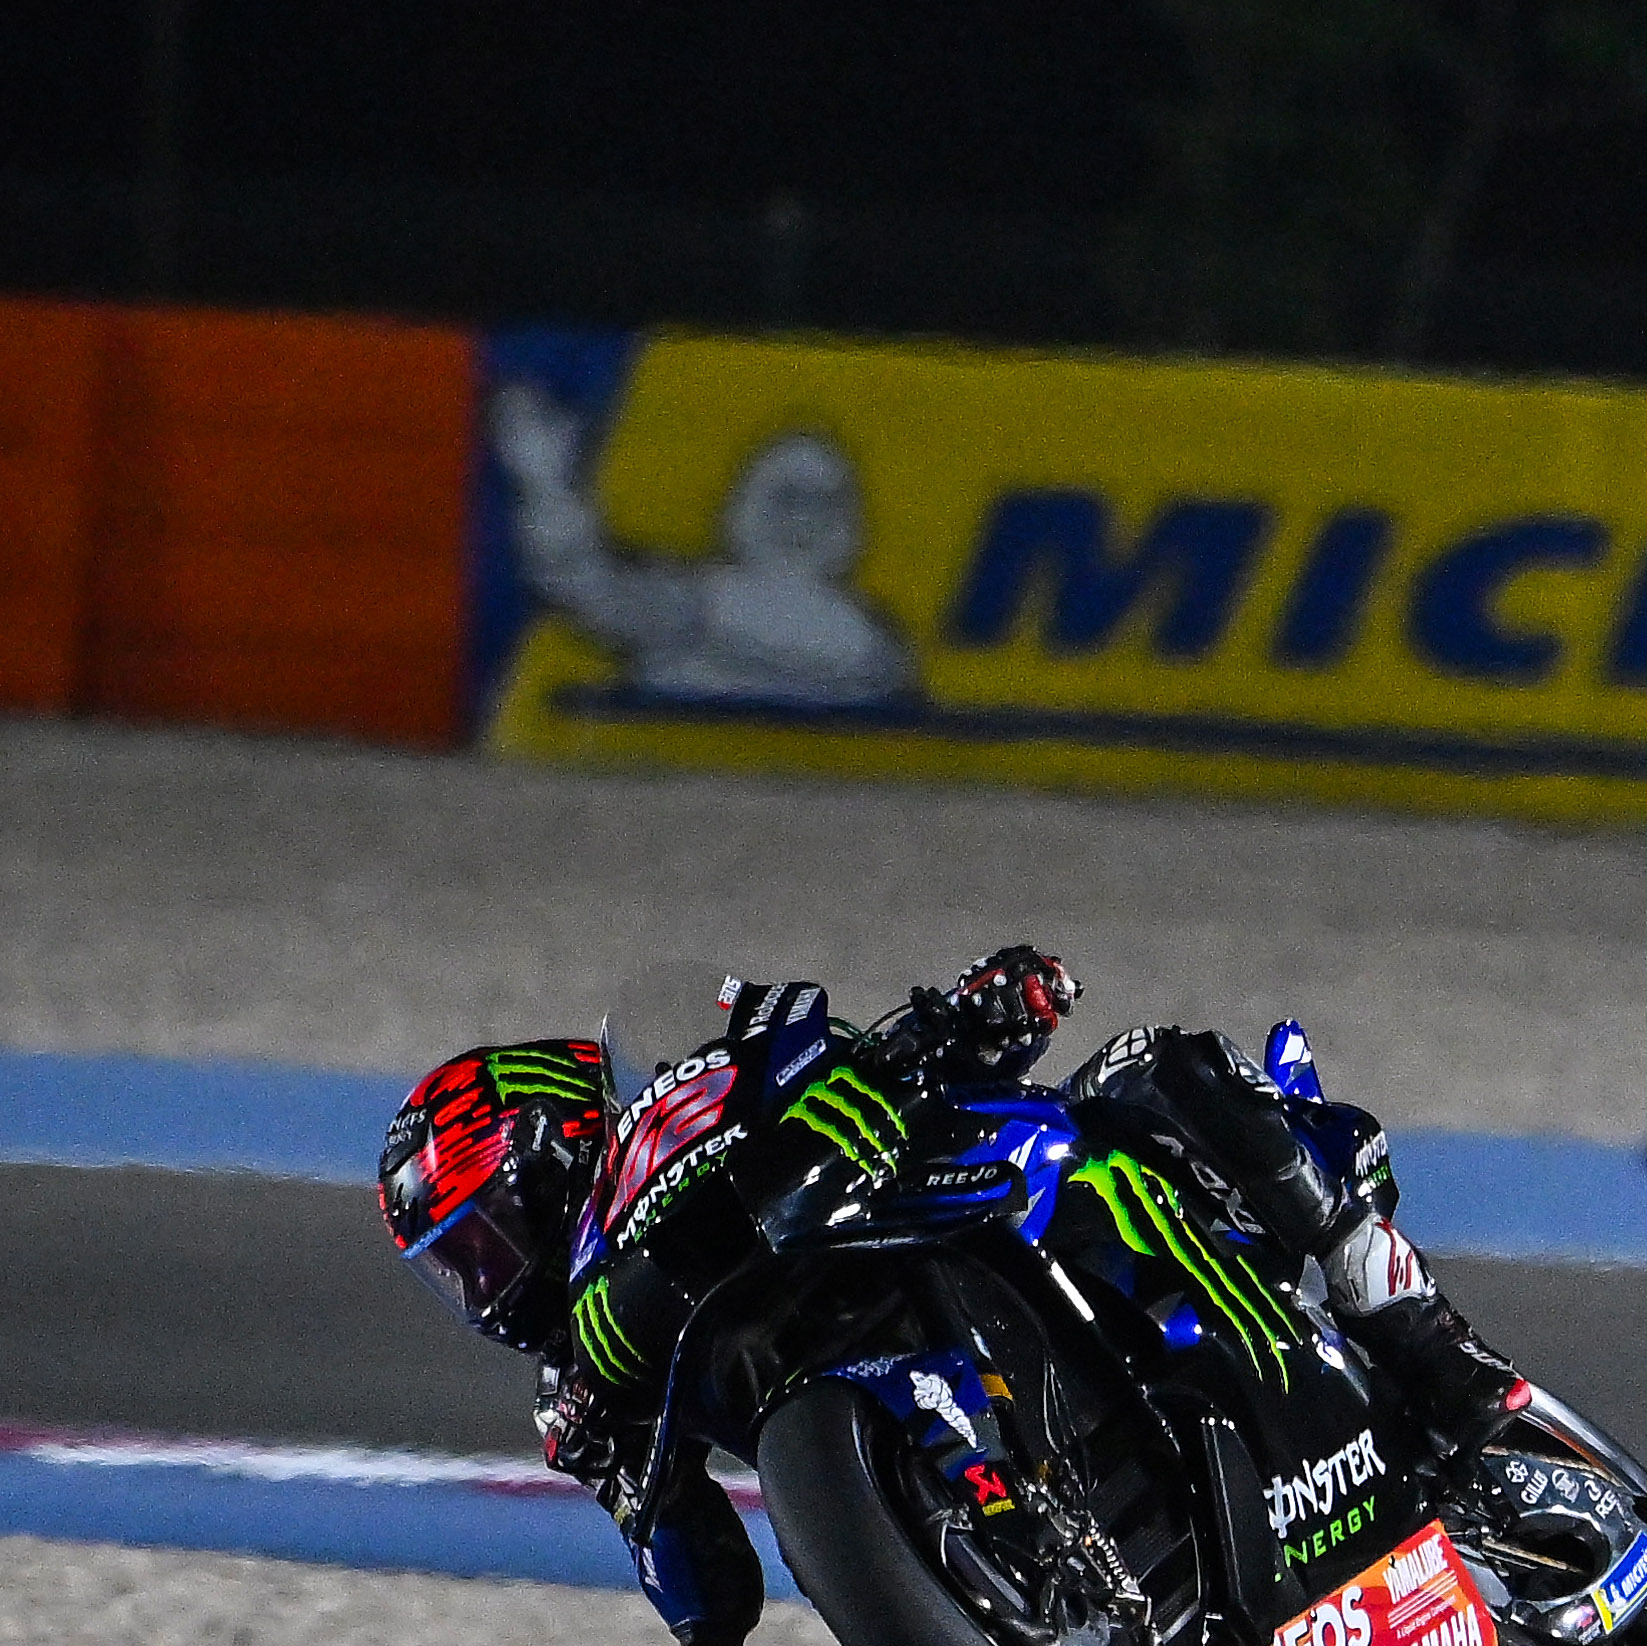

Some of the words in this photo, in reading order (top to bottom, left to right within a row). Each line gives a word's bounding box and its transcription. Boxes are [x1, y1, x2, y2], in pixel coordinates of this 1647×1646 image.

[617, 1050, 731, 1144] ENEOS
[617, 1122, 749, 1249] MONSTER
[1263, 1427, 1387, 1540] ONSTER
[1274, 1496, 1376, 1583] NERGY
[1382, 1532, 1450, 1605] YAMALUBE
